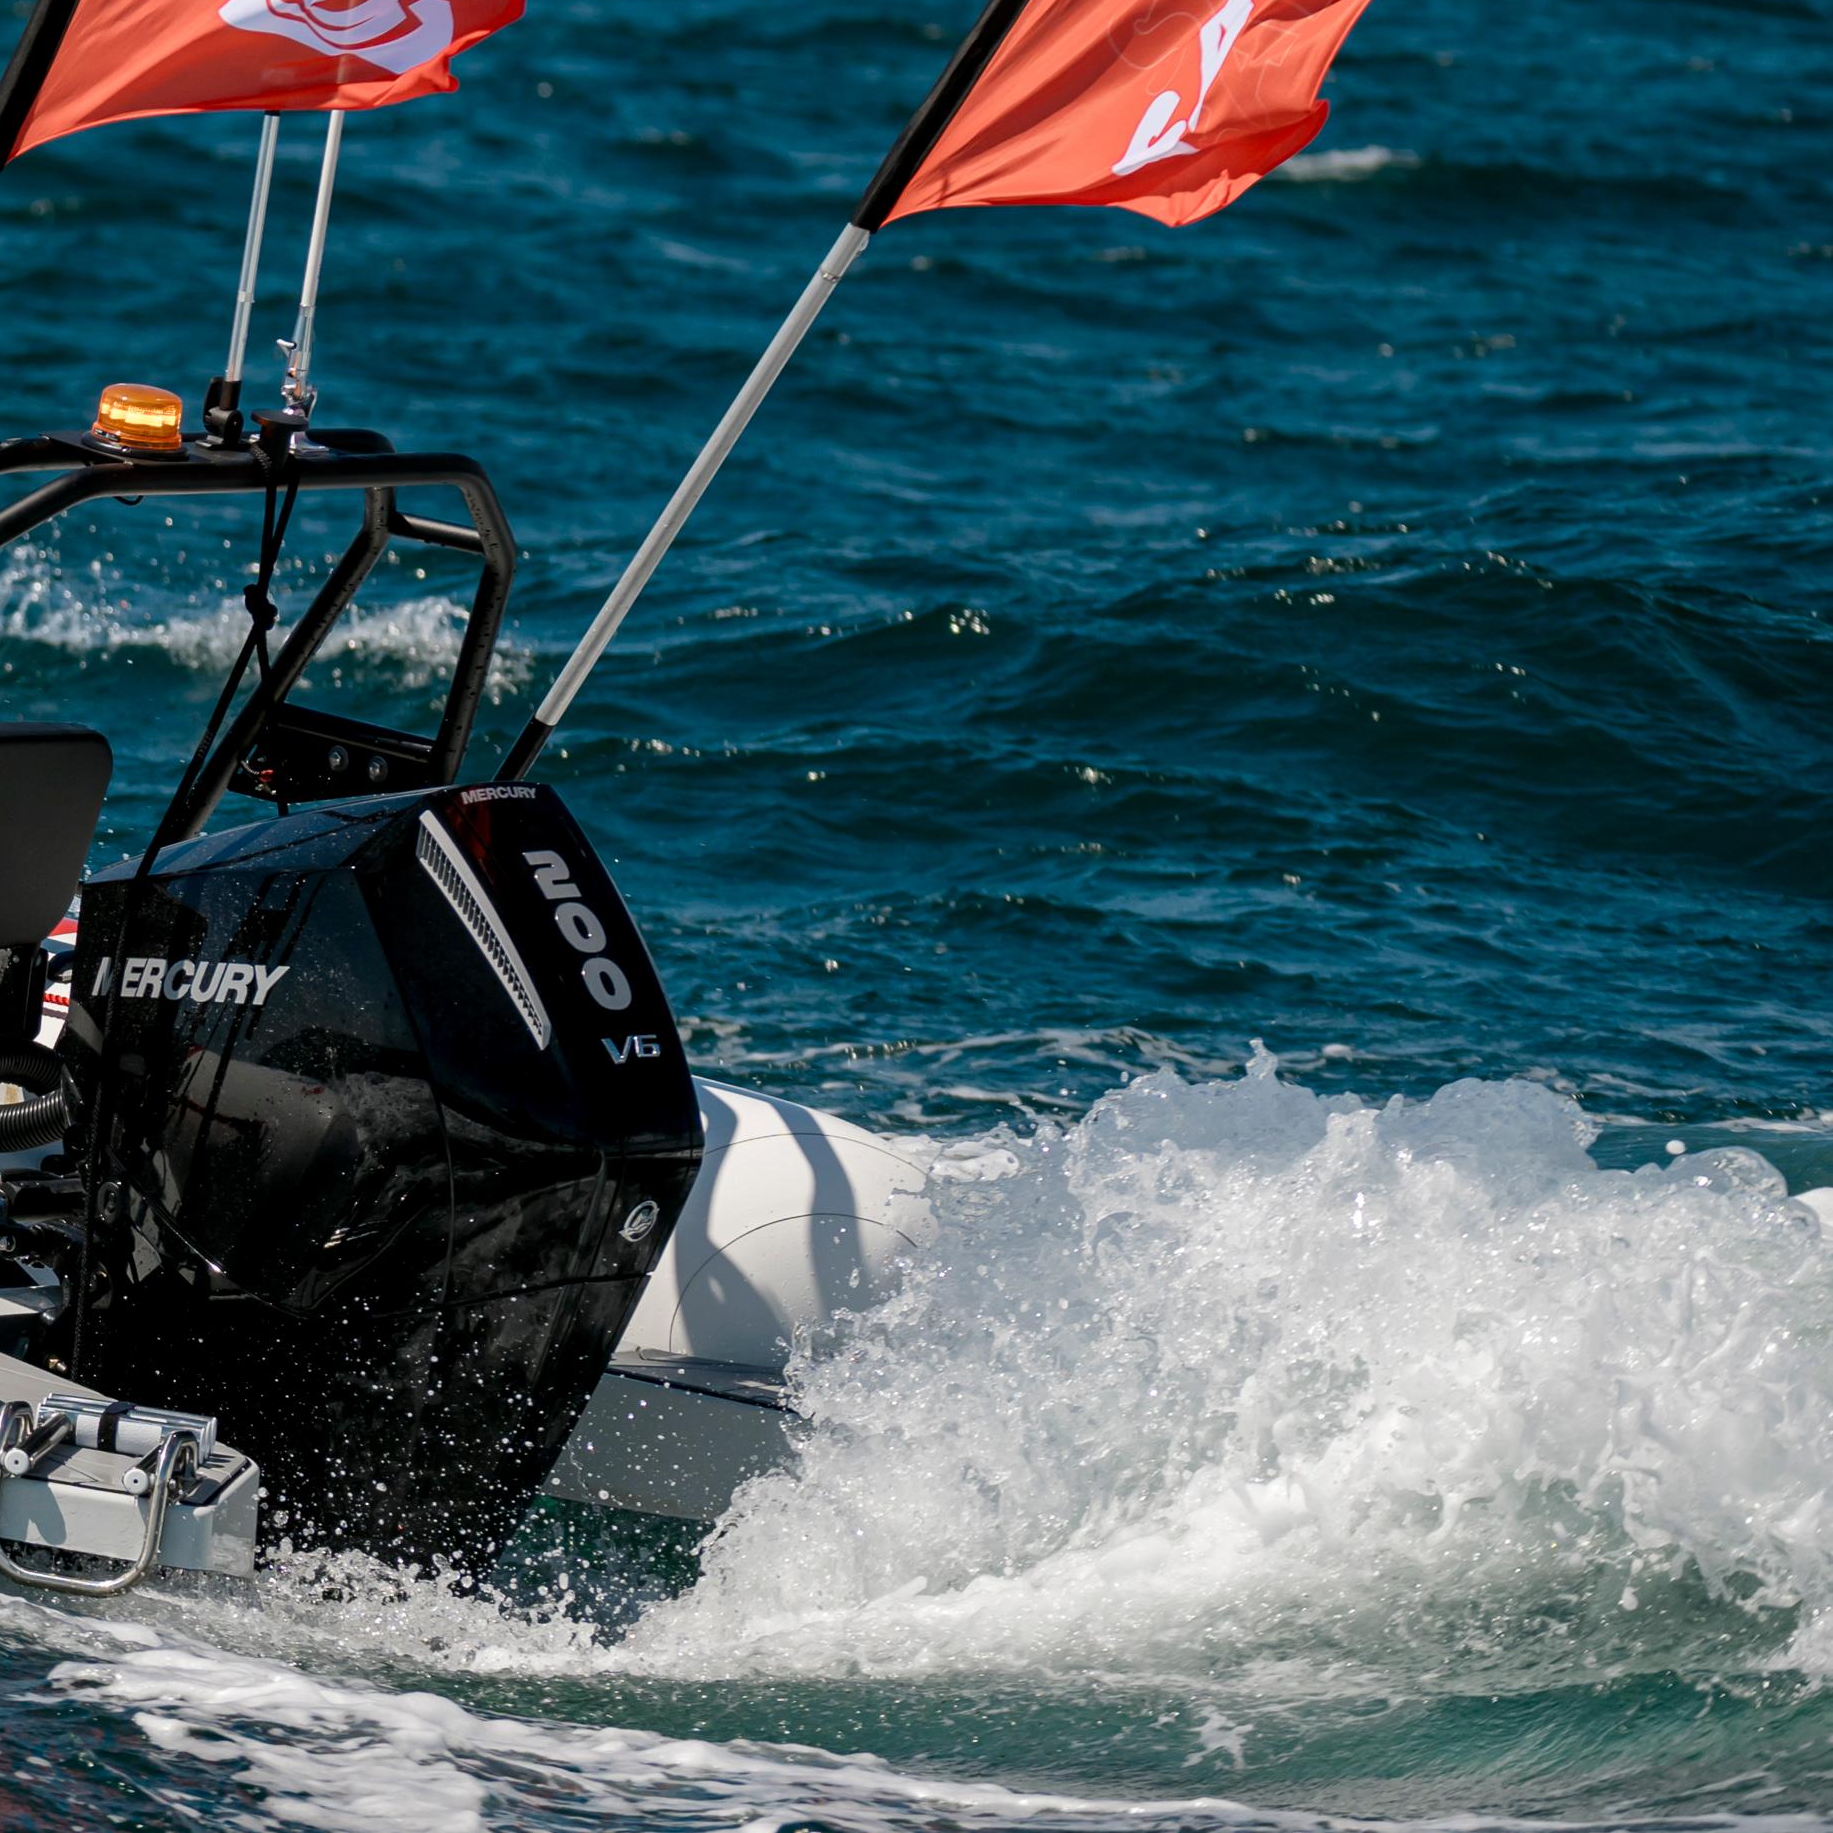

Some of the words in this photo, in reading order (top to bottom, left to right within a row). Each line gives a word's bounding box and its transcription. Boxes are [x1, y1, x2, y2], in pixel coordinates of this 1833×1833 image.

[461, 786, 537, 805] MERCURY
[522, 850, 632, 1011] 200
[601, 1034, 662, 1065] V6
